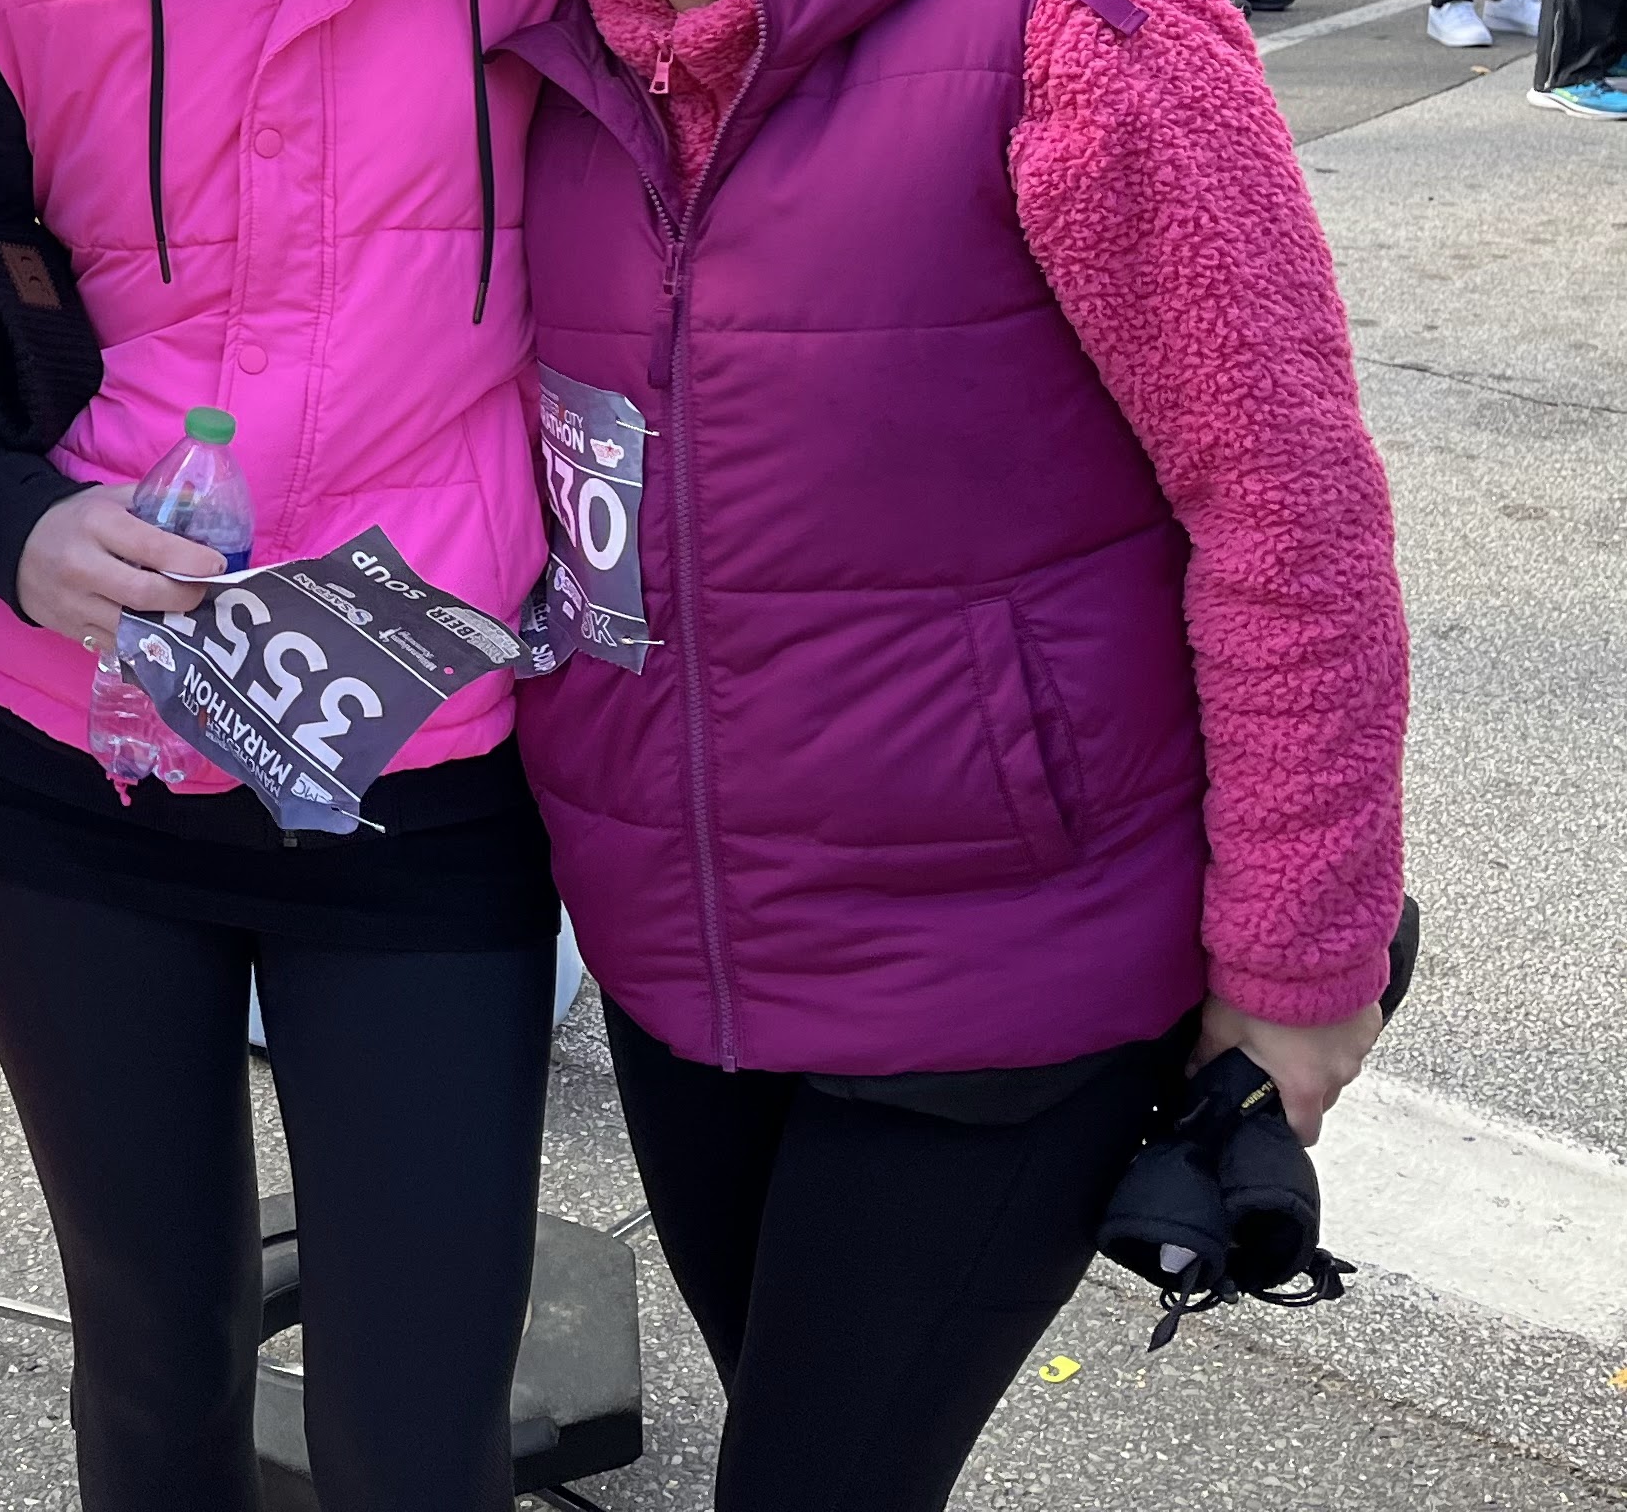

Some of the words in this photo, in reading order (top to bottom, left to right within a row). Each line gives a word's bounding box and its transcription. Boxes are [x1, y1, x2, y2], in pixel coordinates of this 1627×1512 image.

[564, 409, 584, 429] CITY
[351, 550, 428, 600] SOUP
[429, 606, 470, 640] BEER
[163, 587, 384, 772] 355
[178, 688, 201, 716] CITY
[182, 663, 293, 785] MARATHON
